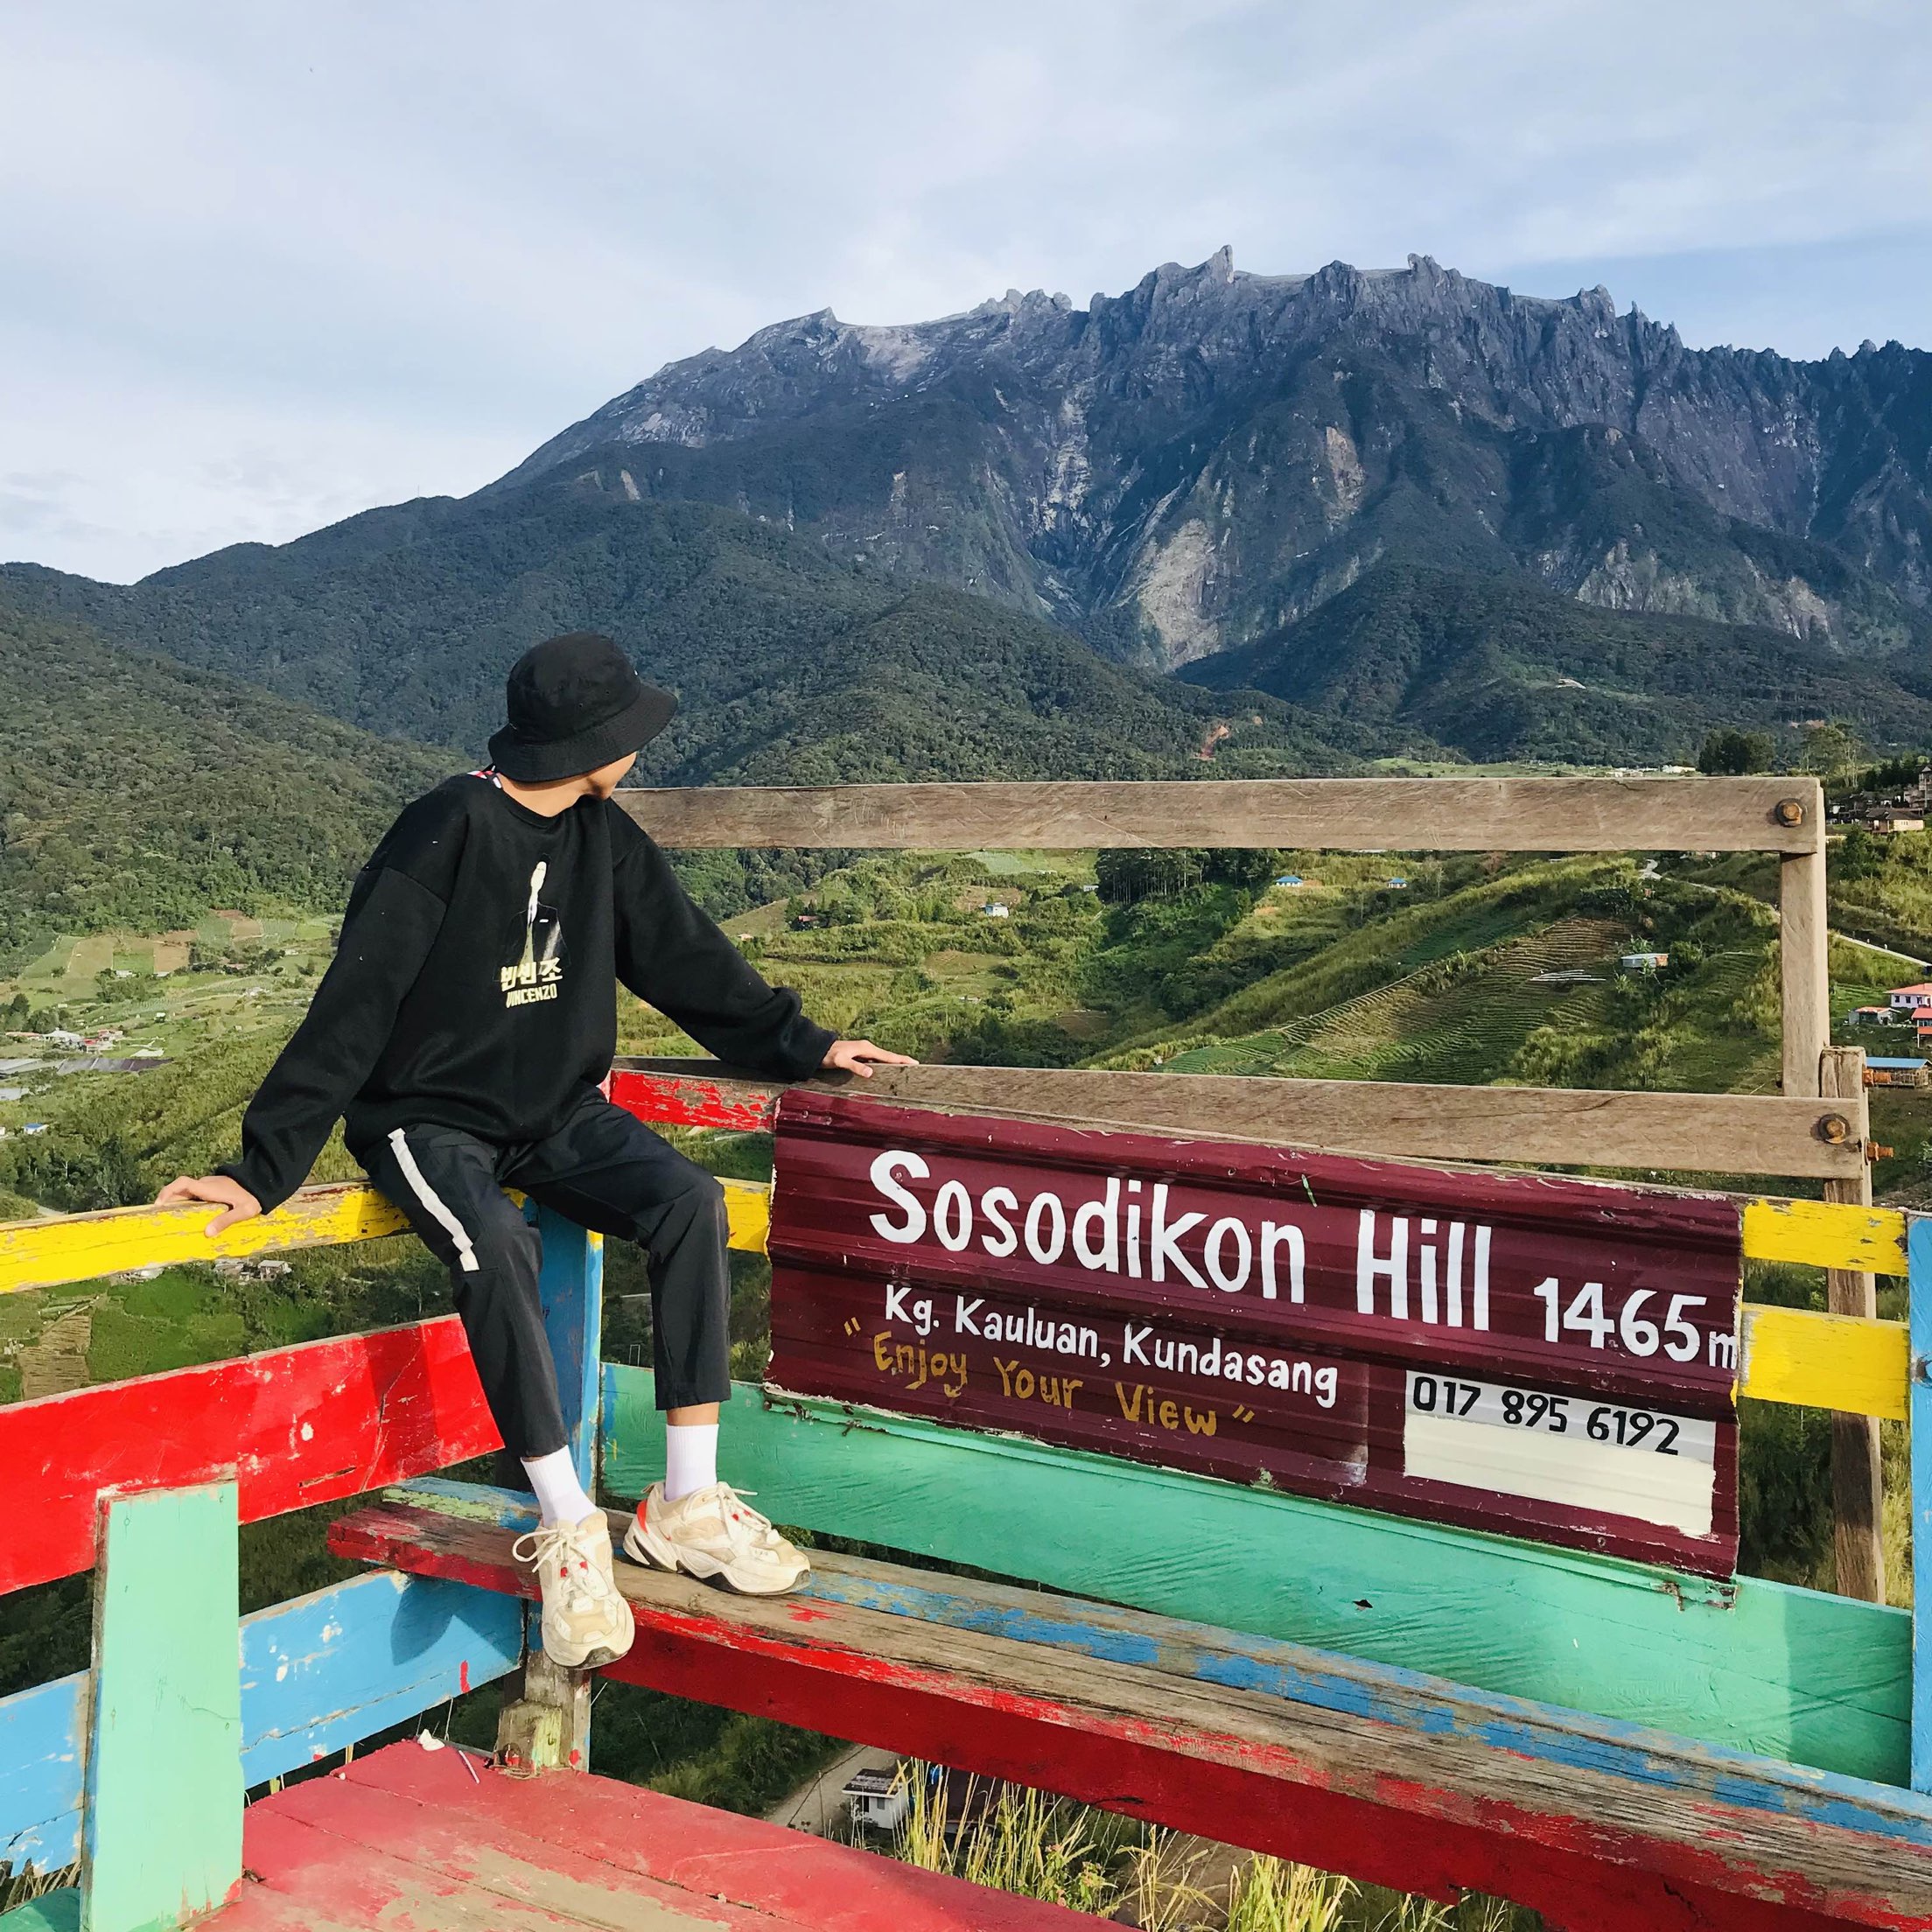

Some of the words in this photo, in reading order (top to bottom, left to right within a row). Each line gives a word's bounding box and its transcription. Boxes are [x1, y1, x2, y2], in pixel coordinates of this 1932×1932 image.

[506, 983, 558, 1009] VINCENZO
[869, 1149, 1306, 1305] Sosodikon
[1356, 1208, 1492, 1332] Hill
[885, 1284, 940, 1337] Kg.
[955, 1295, 1112, 1368] Kauluan,
[1123, 1322, 1339, 1410] Kundasang
[993, 1356, 1084, 1410] Your
[1412, 1376, 1482, 1418] 017
[1501, 1390, 1570, 1433] 895
[1586, 1405, 1681, 1457] 6192
